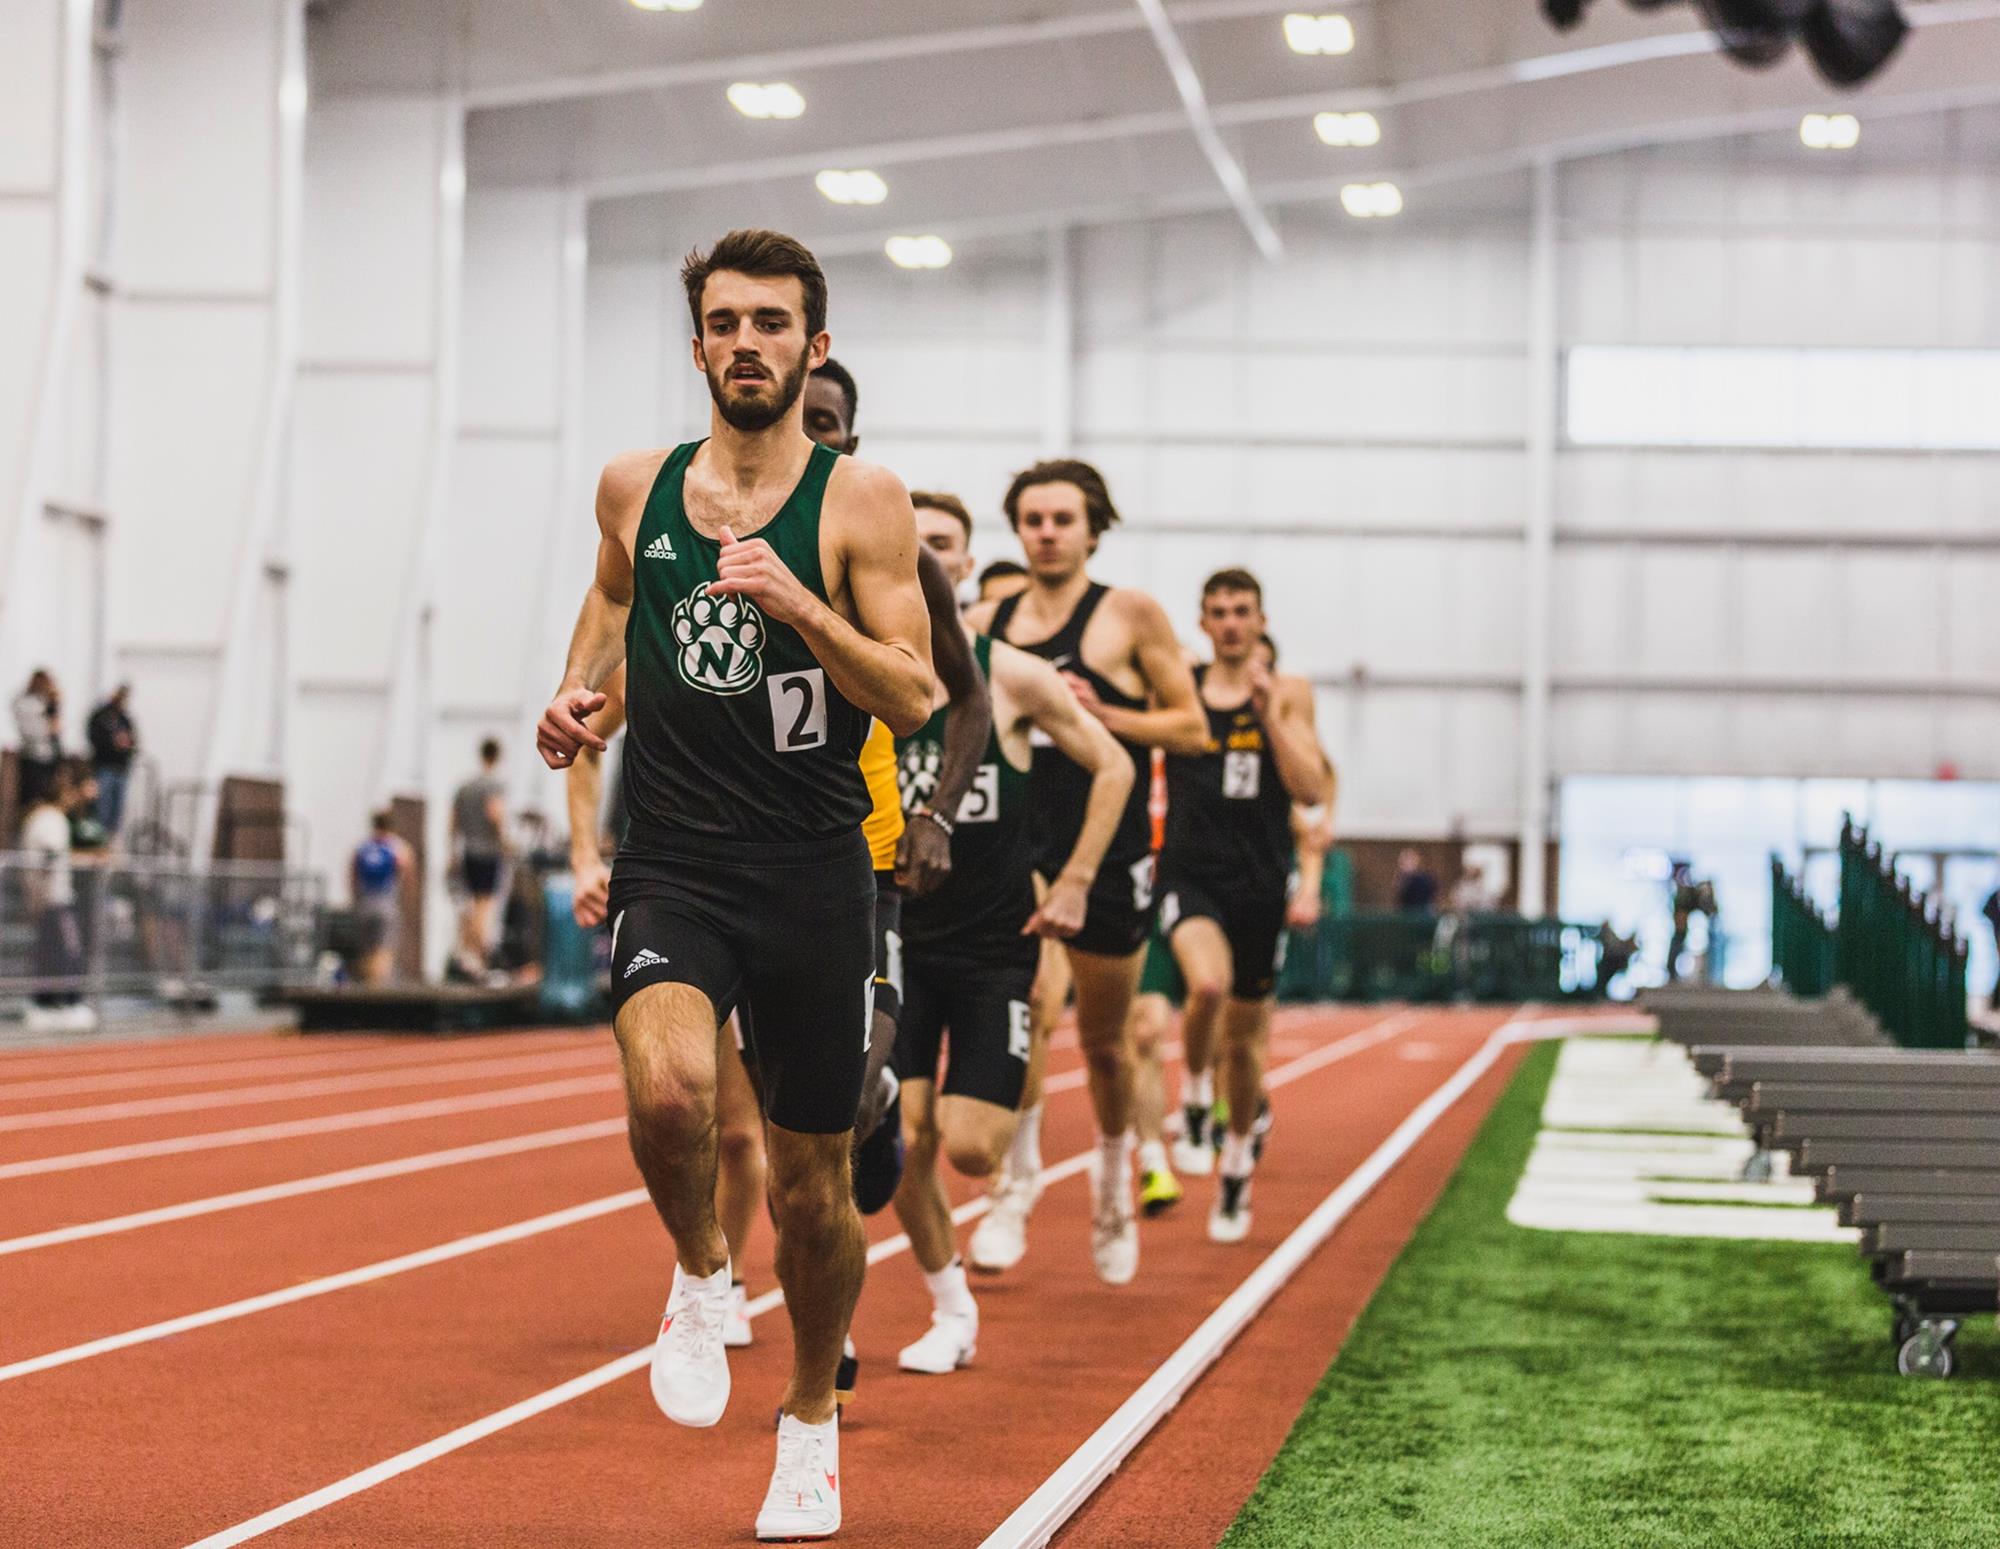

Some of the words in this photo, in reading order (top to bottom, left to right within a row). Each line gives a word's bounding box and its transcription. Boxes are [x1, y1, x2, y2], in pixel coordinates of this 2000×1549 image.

[644, 548, 677, 560] adidas
[694, 640, 734, 680] N
[781, 676, 818, 747] 2
[967, 771, 988, 816] 5
[624, 957, 669, 978] adidas
